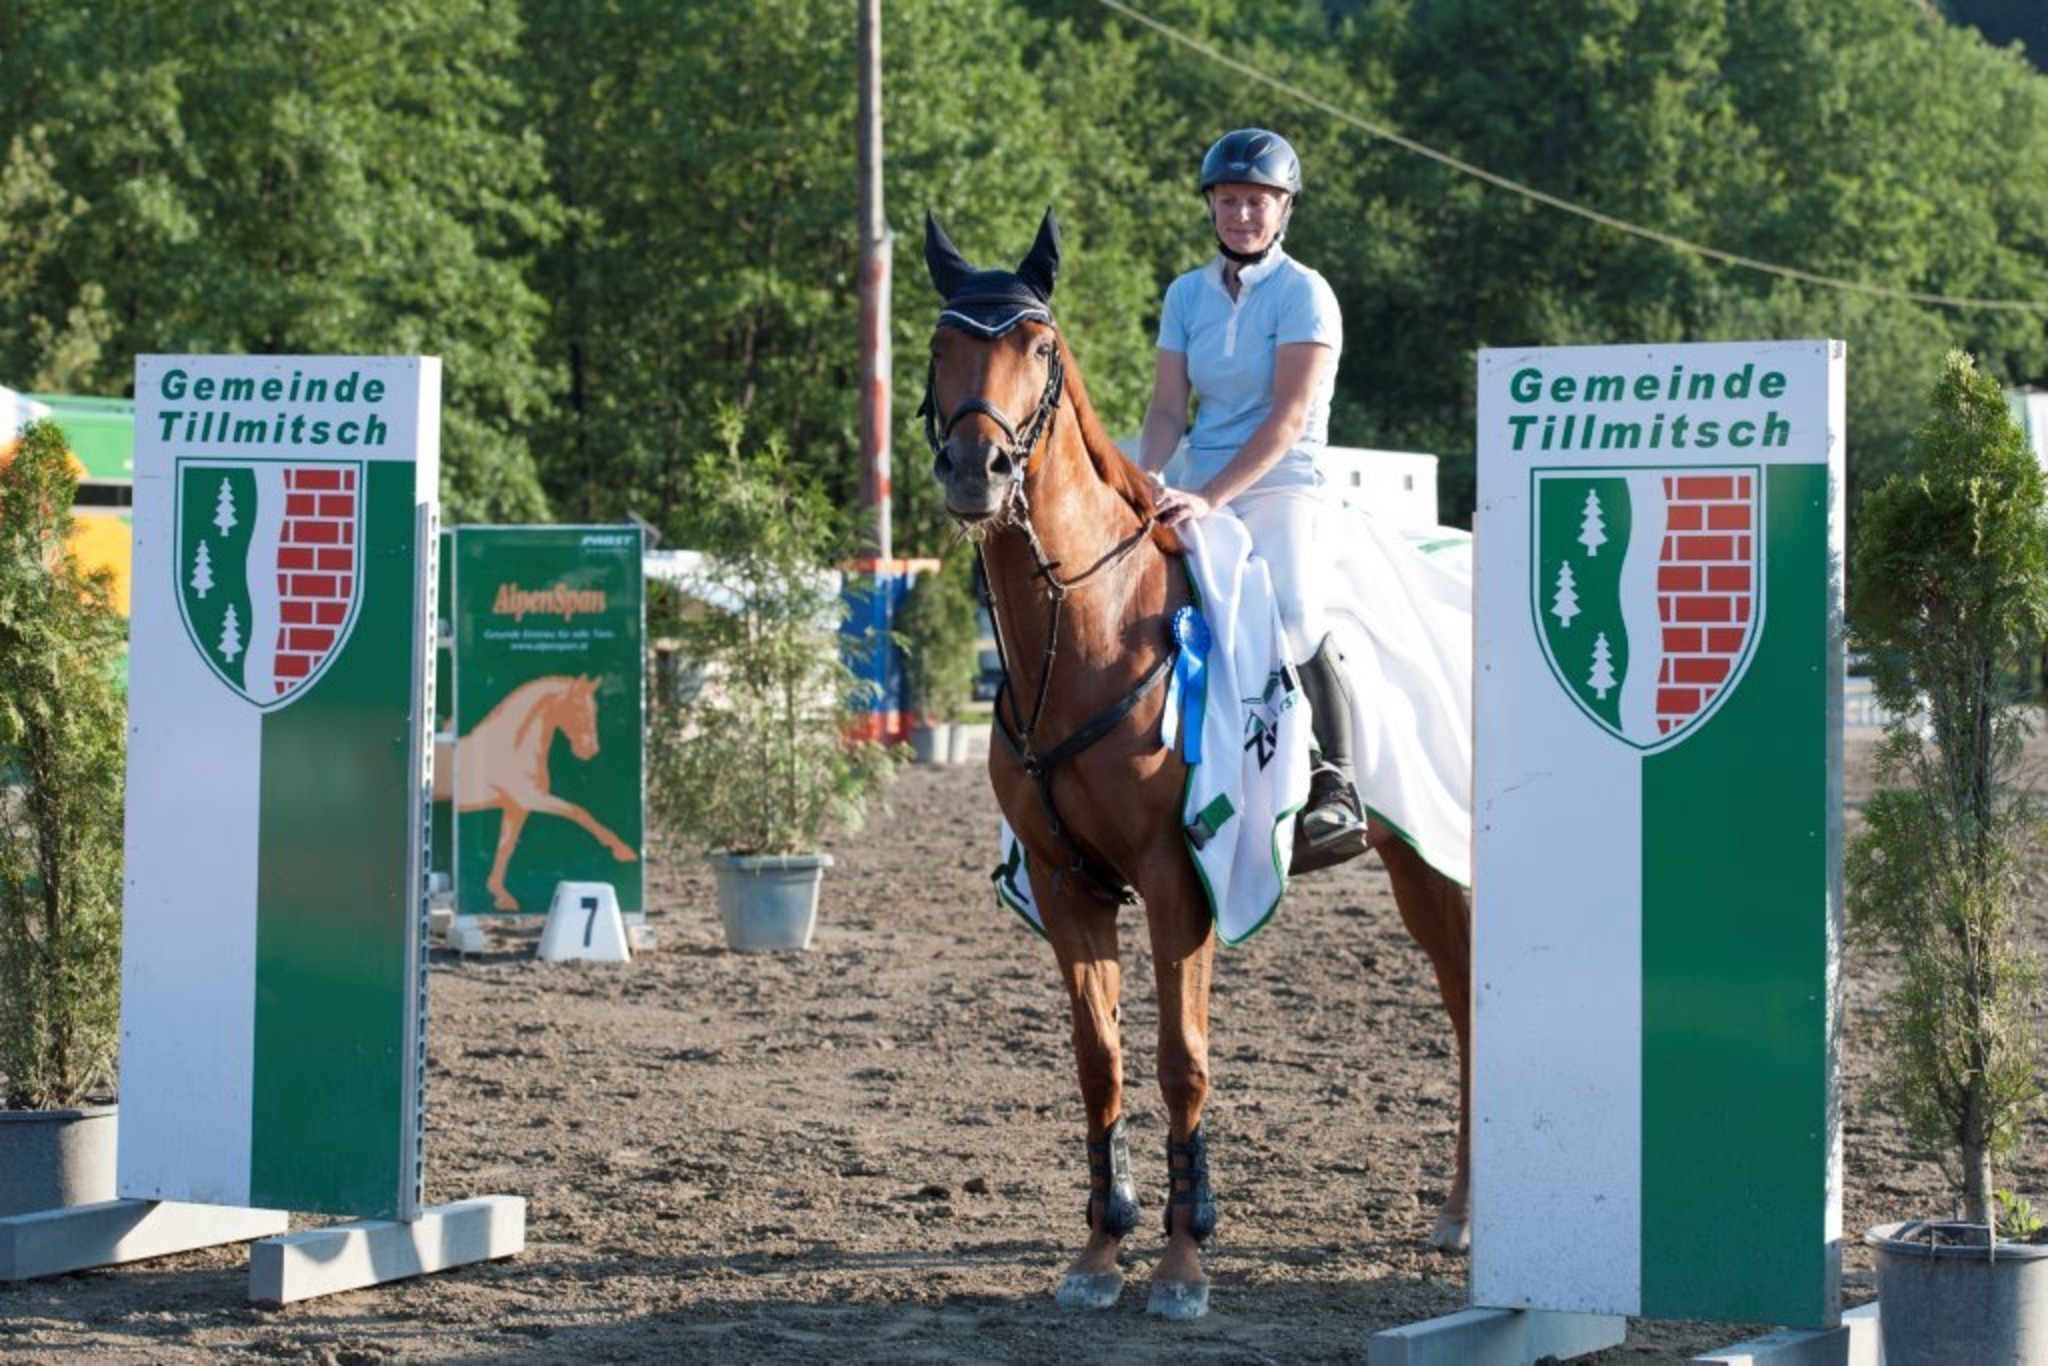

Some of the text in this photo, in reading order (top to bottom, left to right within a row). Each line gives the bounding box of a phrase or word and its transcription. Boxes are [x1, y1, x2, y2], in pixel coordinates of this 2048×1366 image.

[161, 369, 386, 403] Gemeinde
[1510, 363, 1787, 404] Gemeinde
[158, 411, 388, 445] Tillmitsch
[1508, 411, 1792, 451] Tillmitsch
[493, 582, 607, 622] AlpenSpan
[580, 897, 599, 949] 7
